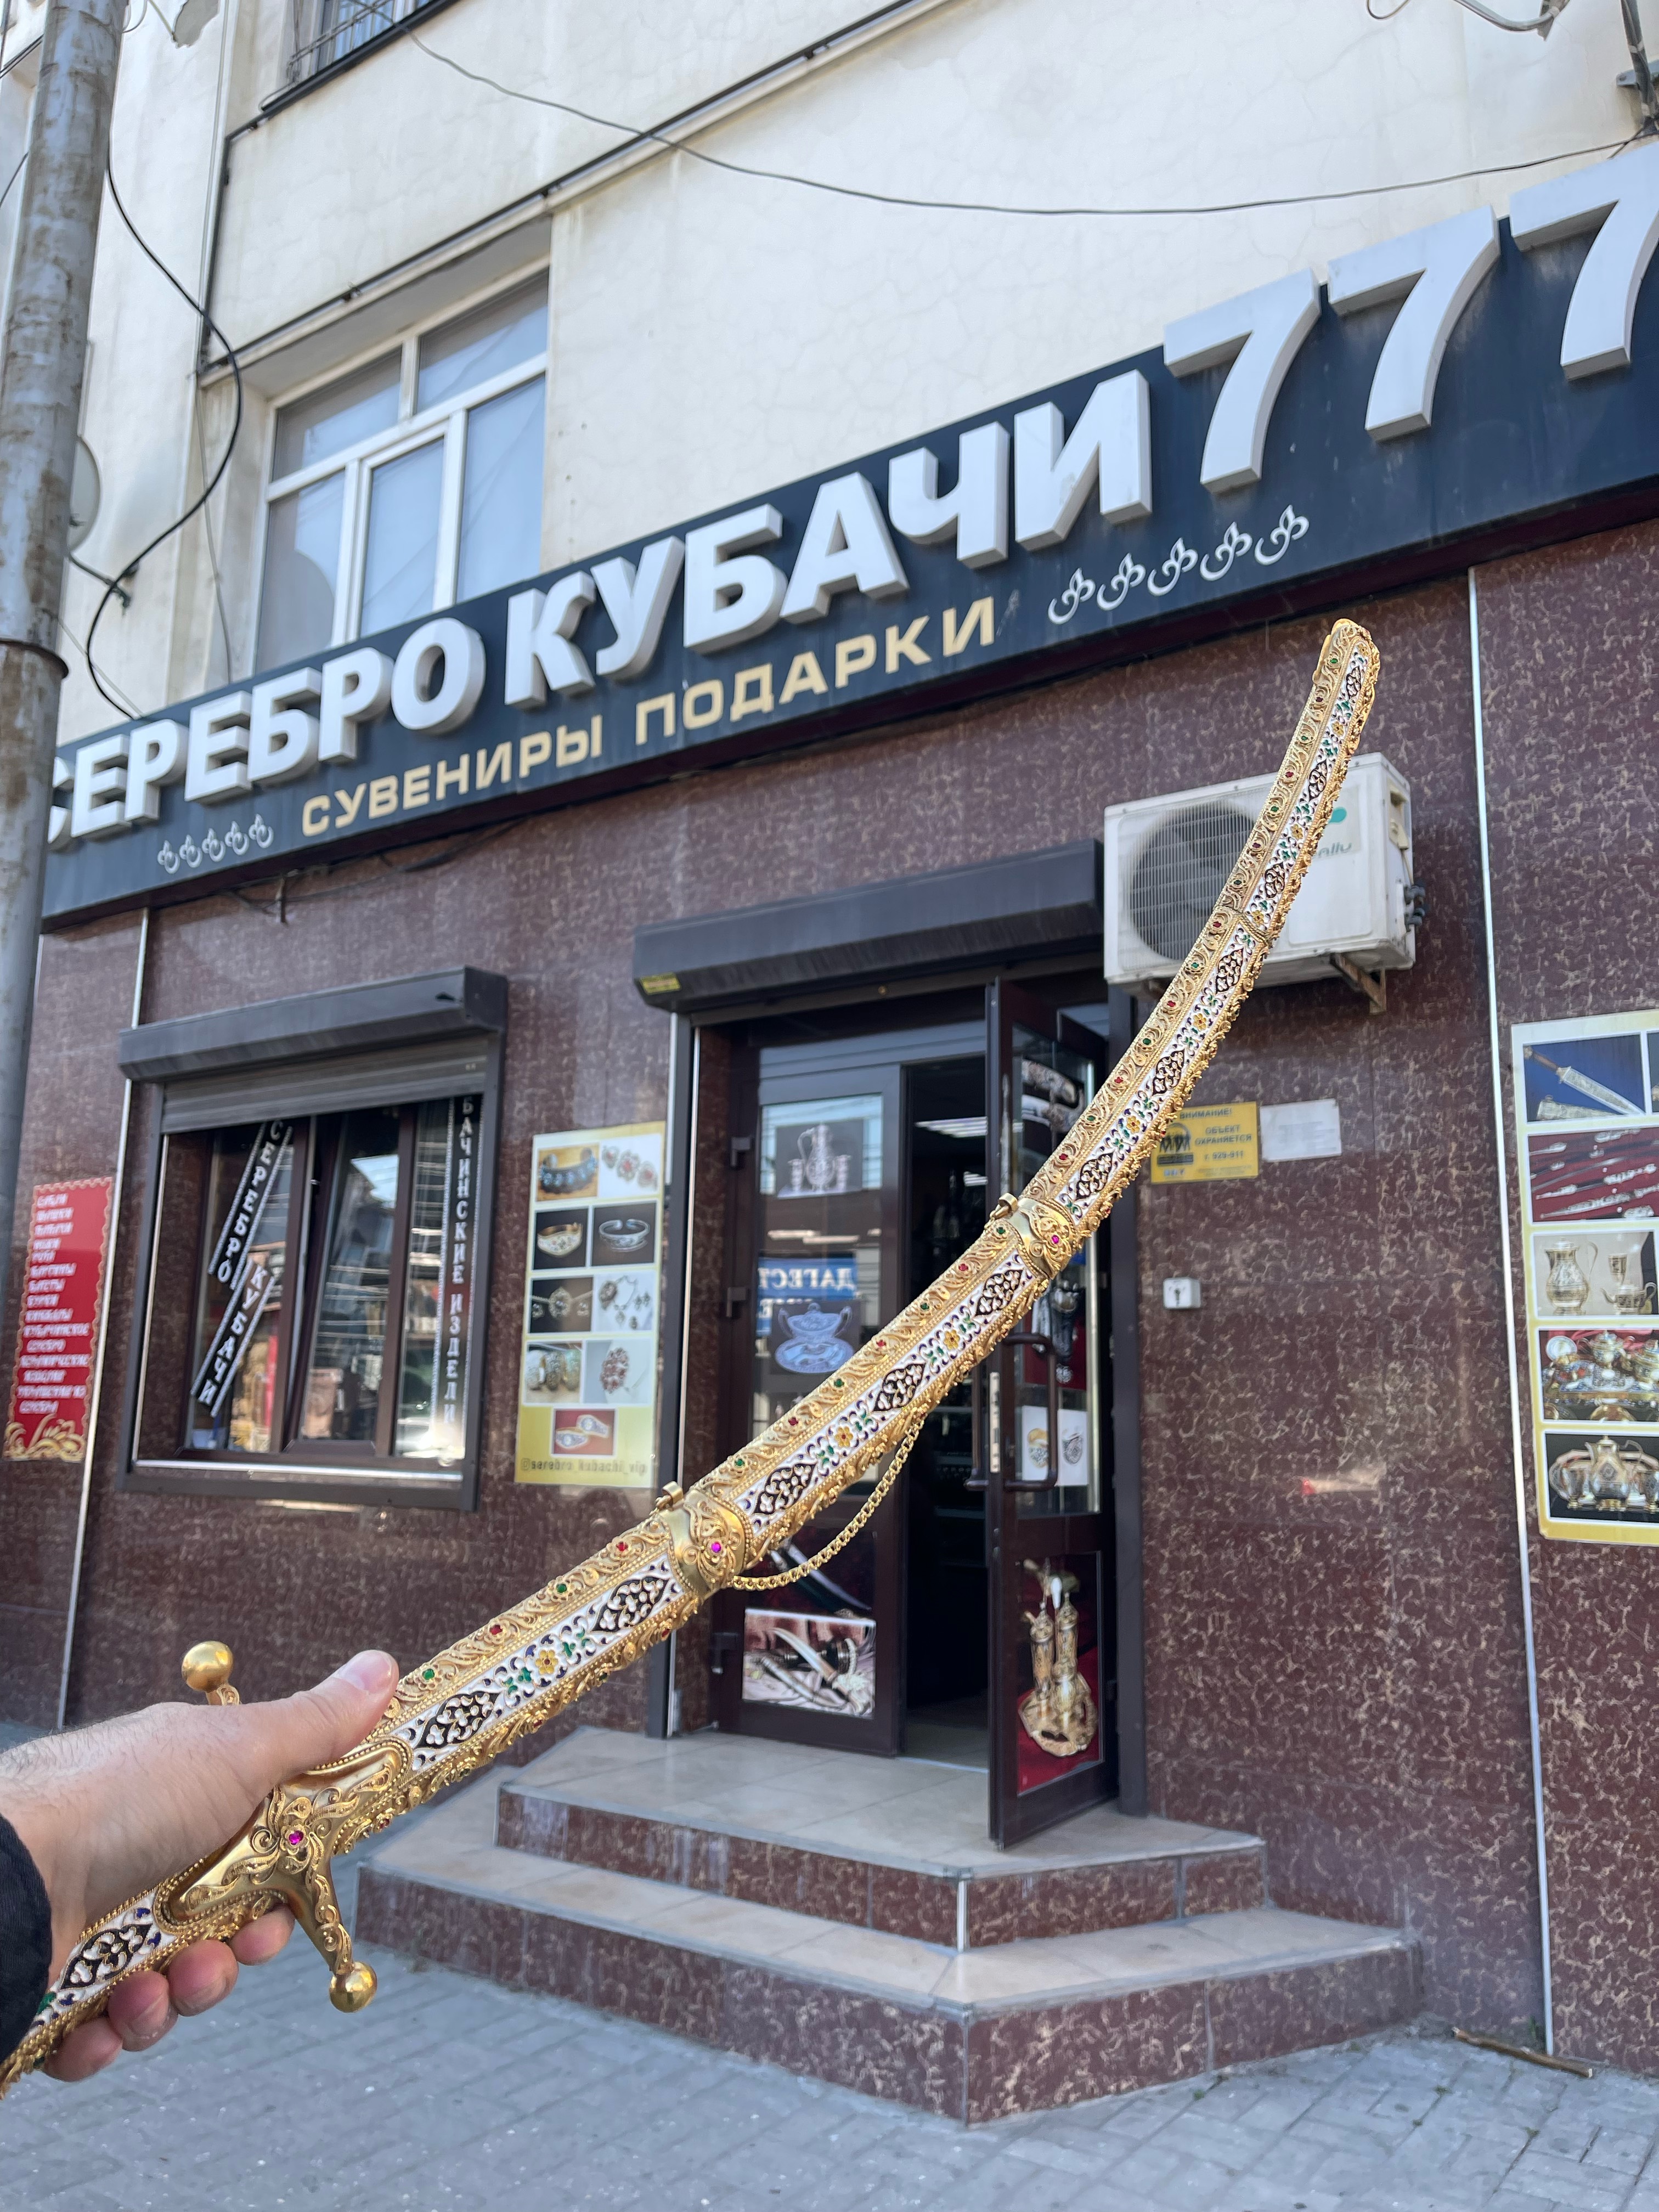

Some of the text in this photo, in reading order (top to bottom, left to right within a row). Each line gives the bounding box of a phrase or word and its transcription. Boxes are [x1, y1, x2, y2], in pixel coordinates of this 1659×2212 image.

[504, 369, 1152, 709] КУБАЧИ
[1163, 141, 1659, 494] 777
[302, 596, 994, 837] СУВЕНИРЫ ПОДАРКИ
[1180, 1108, 1232, 1120] ВНИМАНИЕ!
[1195, 1133, 1252, 1145] ОХРАНЯЕТСЯ
[1205, 1125, 1241, 1135] ОБЪЕКТ
[217, 1120, 284, 1284] СЕРЕБРО
[198, 1263, 268, 1407] КУБАЧИ
[443, 1292, 463, 1424] ИЗДЕЛИ
